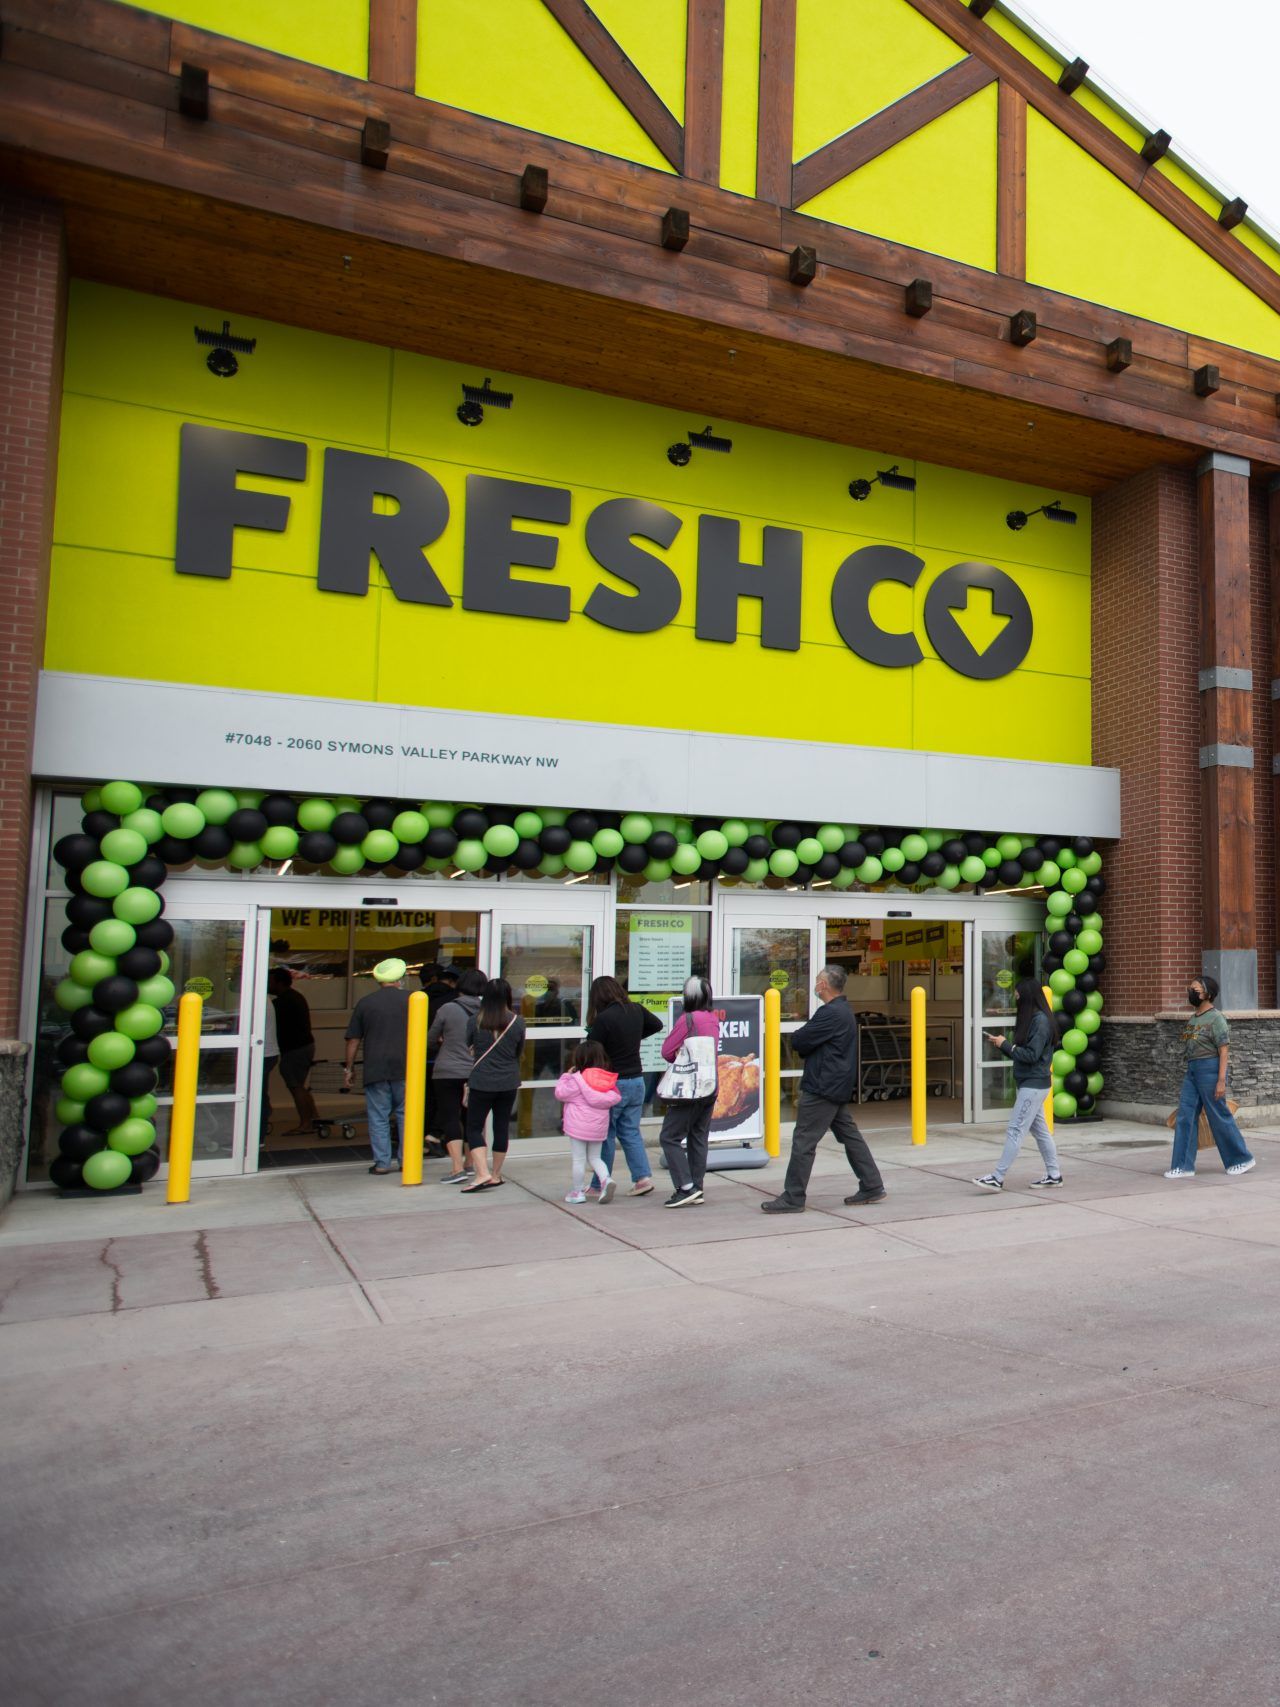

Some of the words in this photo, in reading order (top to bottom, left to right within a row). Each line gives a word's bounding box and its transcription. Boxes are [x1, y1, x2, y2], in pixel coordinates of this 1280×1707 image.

[225, 732, 272, 747] #7048
[287, 738, 323, 751] 2060
[327, 741, 394, 756] SYMONS
[401, 746, 458, 761] VALLEY
[462, 751, 532, 767] PARKWAY
[536, 757, 559, 768] NW
[282, 909, 311, 926] WE
[377, 911, 435, 928] MATCH
[718, 1021, 750, 1038] KEN
